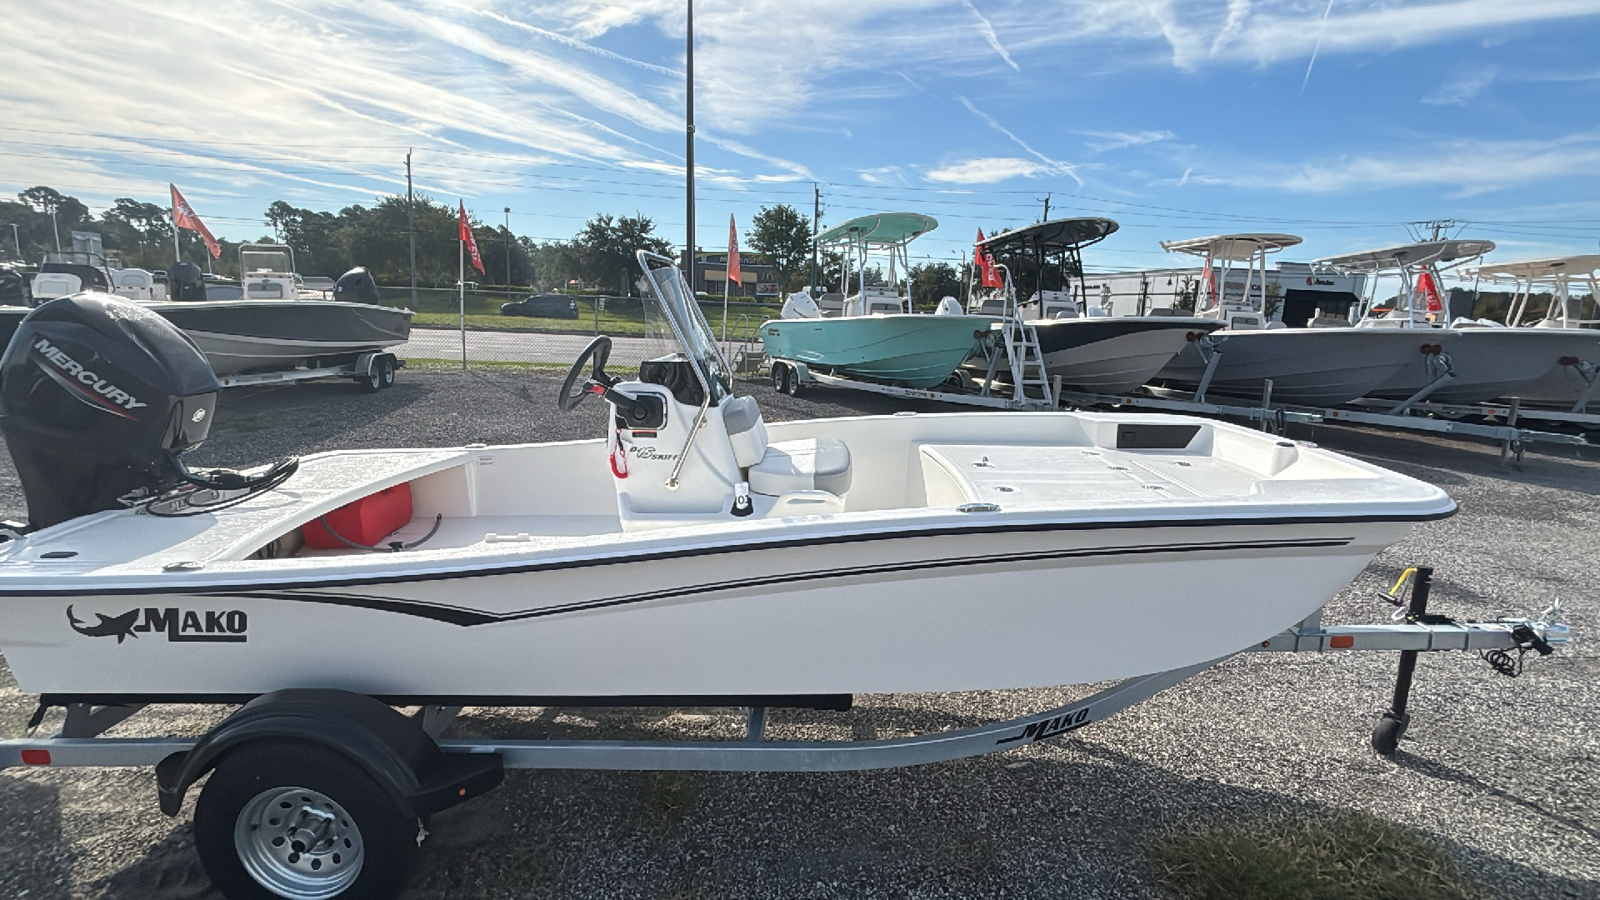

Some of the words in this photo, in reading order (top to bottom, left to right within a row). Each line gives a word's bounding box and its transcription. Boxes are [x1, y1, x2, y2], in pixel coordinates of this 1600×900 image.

[34, 338, 148, 409] MERCURY
[133, 607, 248, 642] MAKO
[995, 707, 1092, 746] MAKO
